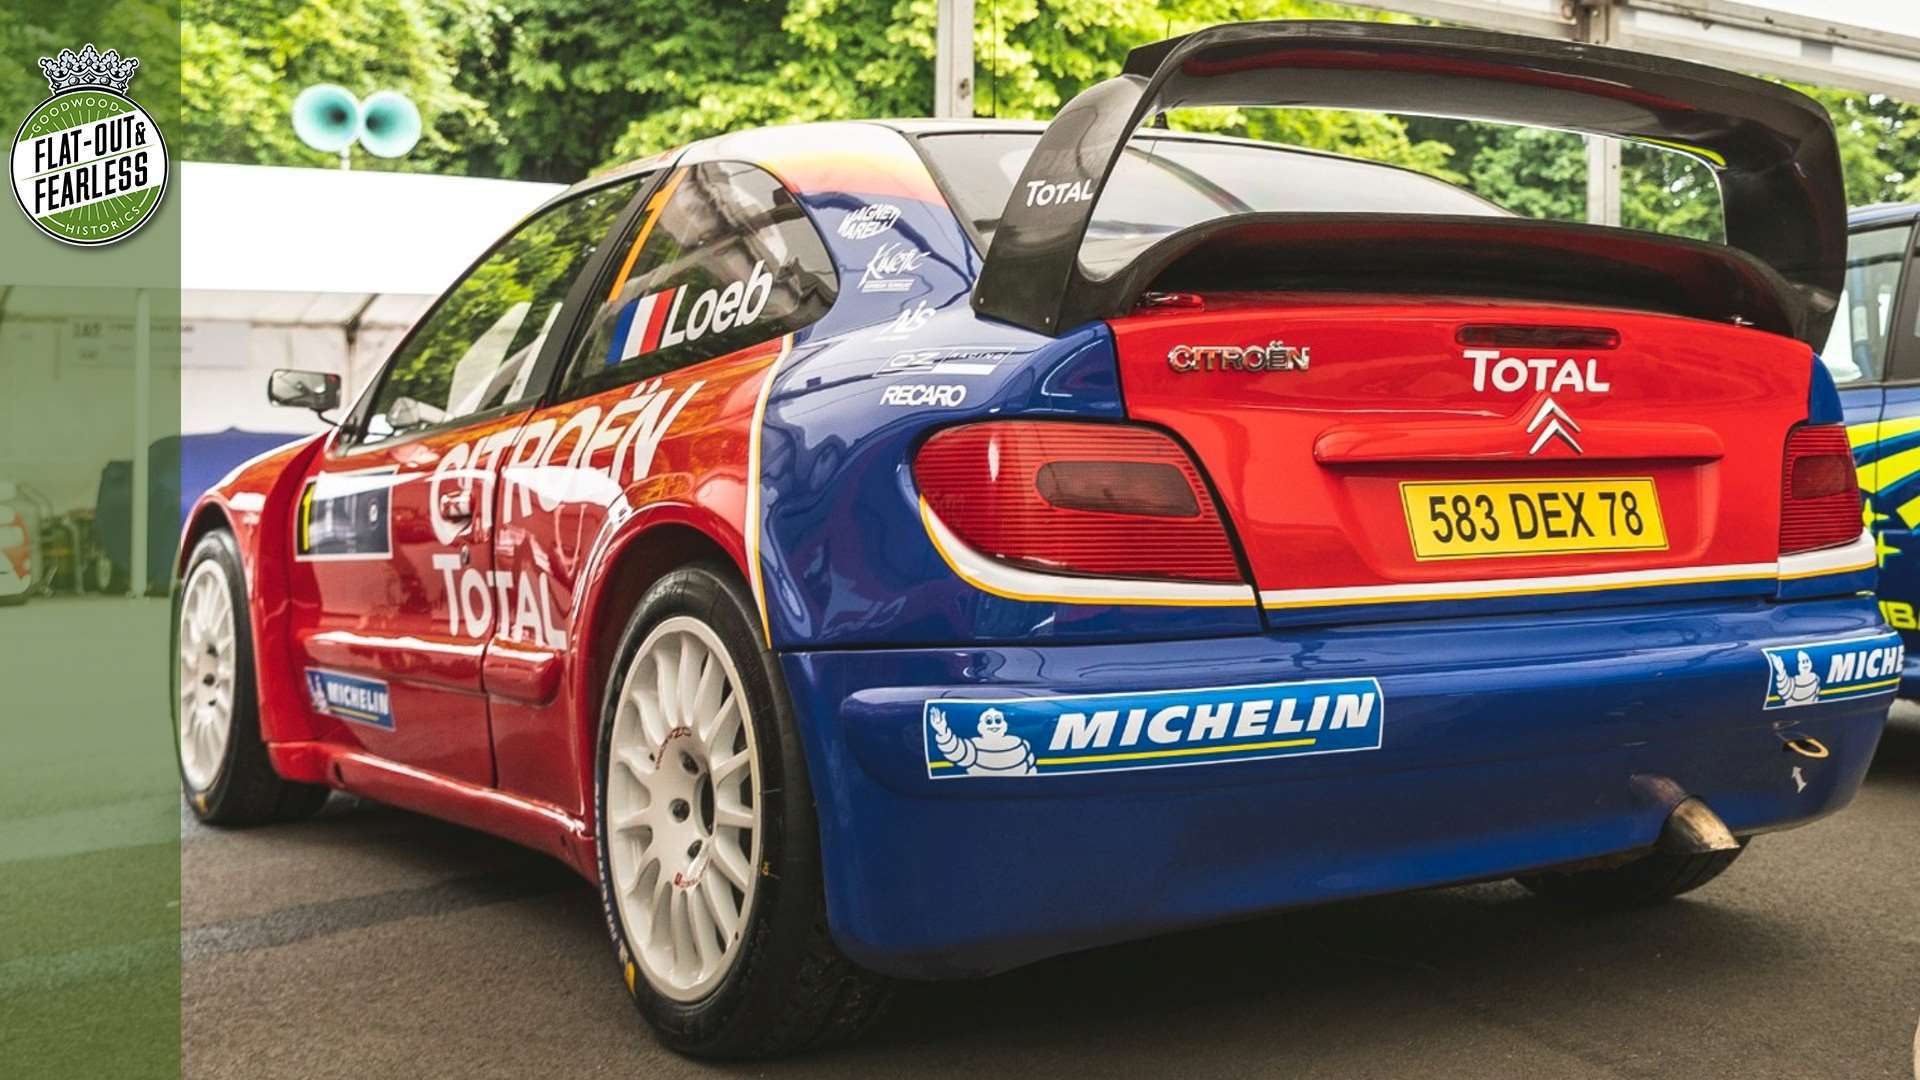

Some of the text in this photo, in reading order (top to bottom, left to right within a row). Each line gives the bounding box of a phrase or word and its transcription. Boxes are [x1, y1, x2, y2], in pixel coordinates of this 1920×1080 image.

[1026, 180, 1094, 207] TOTAL
[659, 259, 773, 350] Loeb
[1168, 340, 1310, 372] CITROËN
[1463, 349, 1610, 392] TOTAL
[879, 384, 967, 406] RECARO
[1429, 490, 1644, 543] 583 DEX 78
[432, 553, 568, 650] TOTAL
[327, 681, 389, 715] MICHELIN
[1048, 692, 1376, 751] MICHELIN
